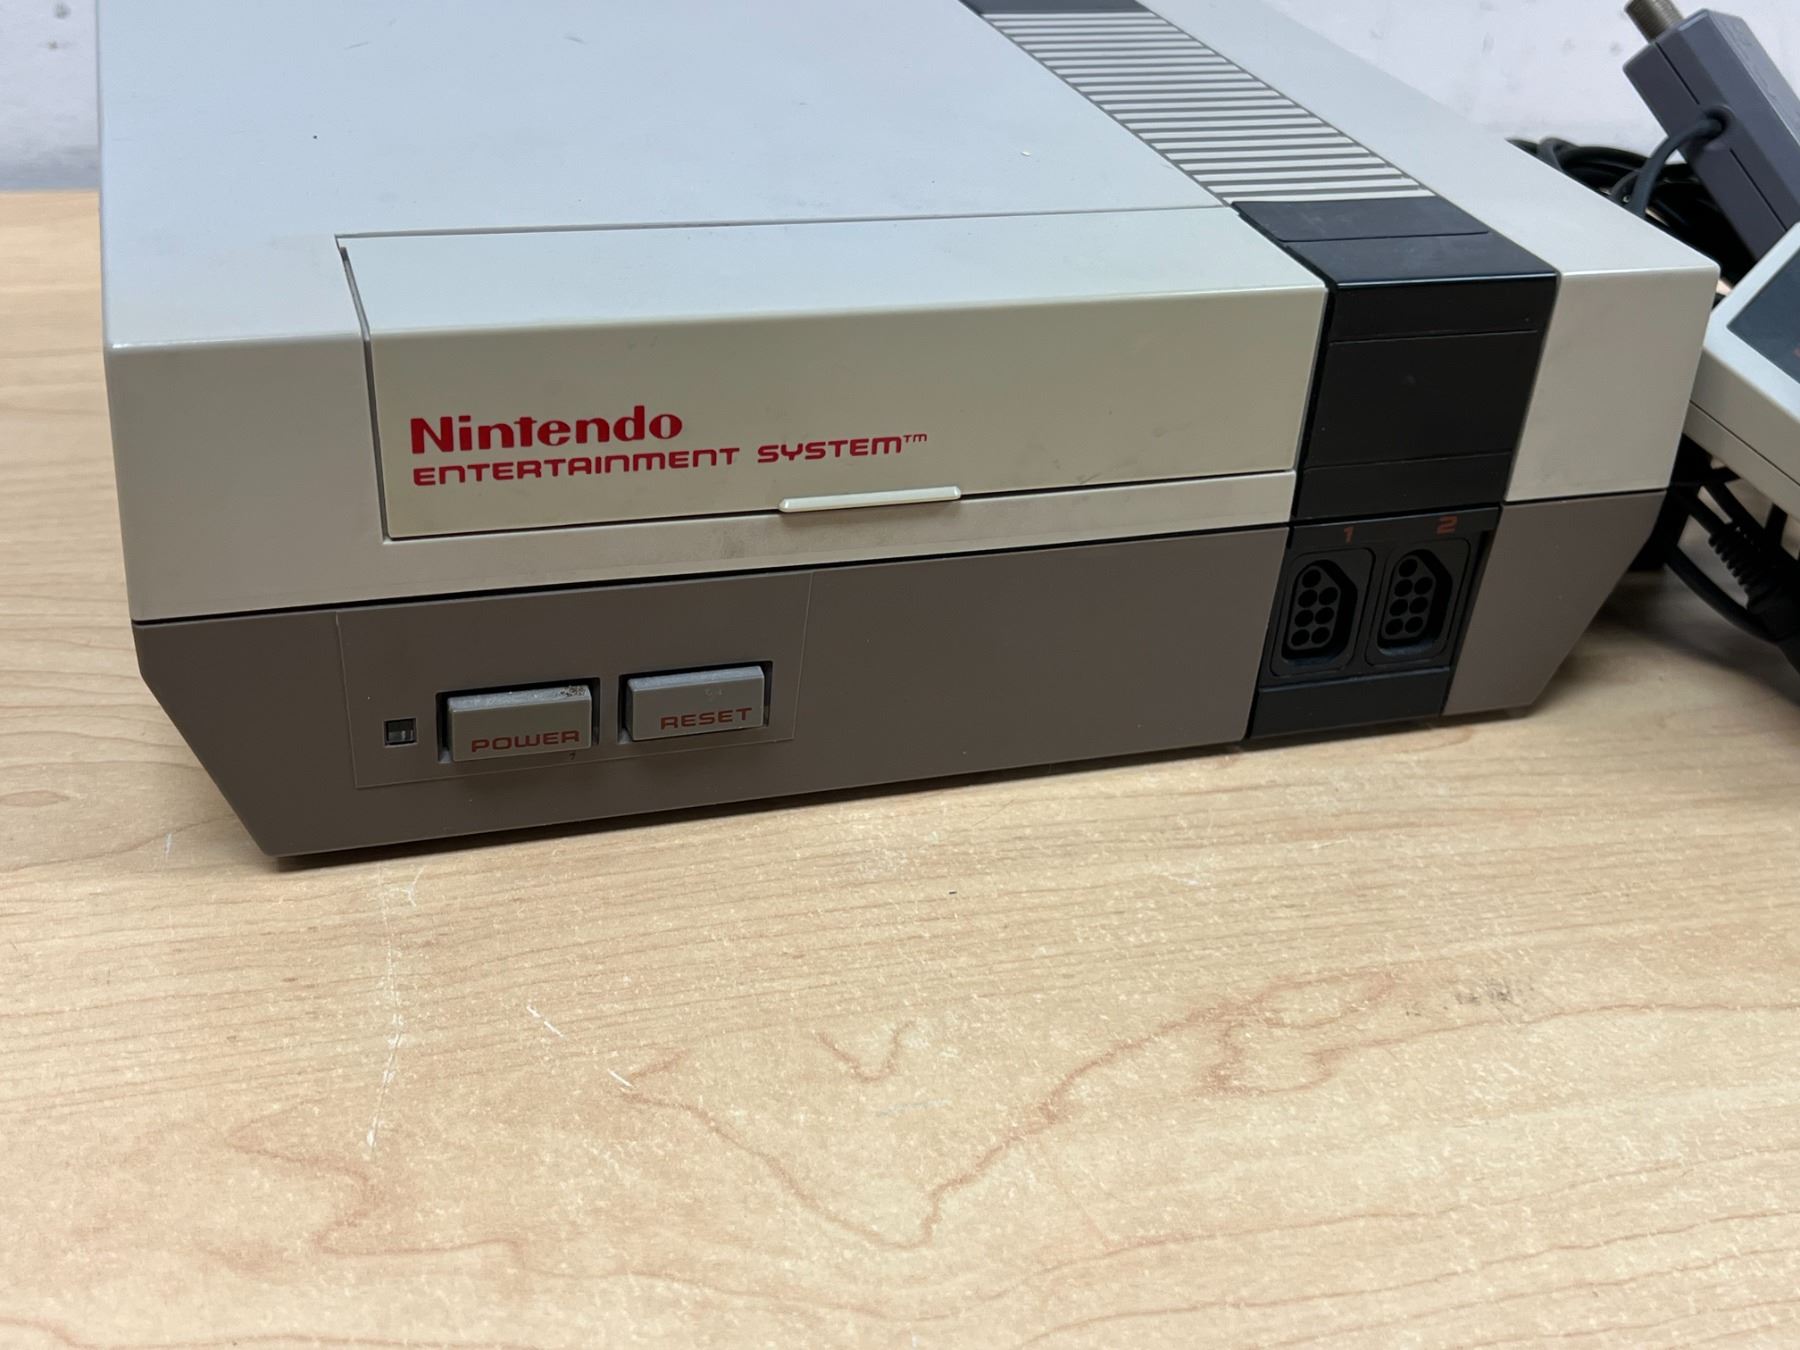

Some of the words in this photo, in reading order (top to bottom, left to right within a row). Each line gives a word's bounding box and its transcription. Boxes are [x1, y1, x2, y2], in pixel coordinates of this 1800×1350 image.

[409, 404, 684, 455] Nintendo
[412, 447, 741, 487] ENTERTAINMENT
[1342, 526, 1355, 543] 1
[1436, 515, 1458, 534] 2
[660, 707, 753, 730] RESET
[471, 730, 581, 753] POWER
